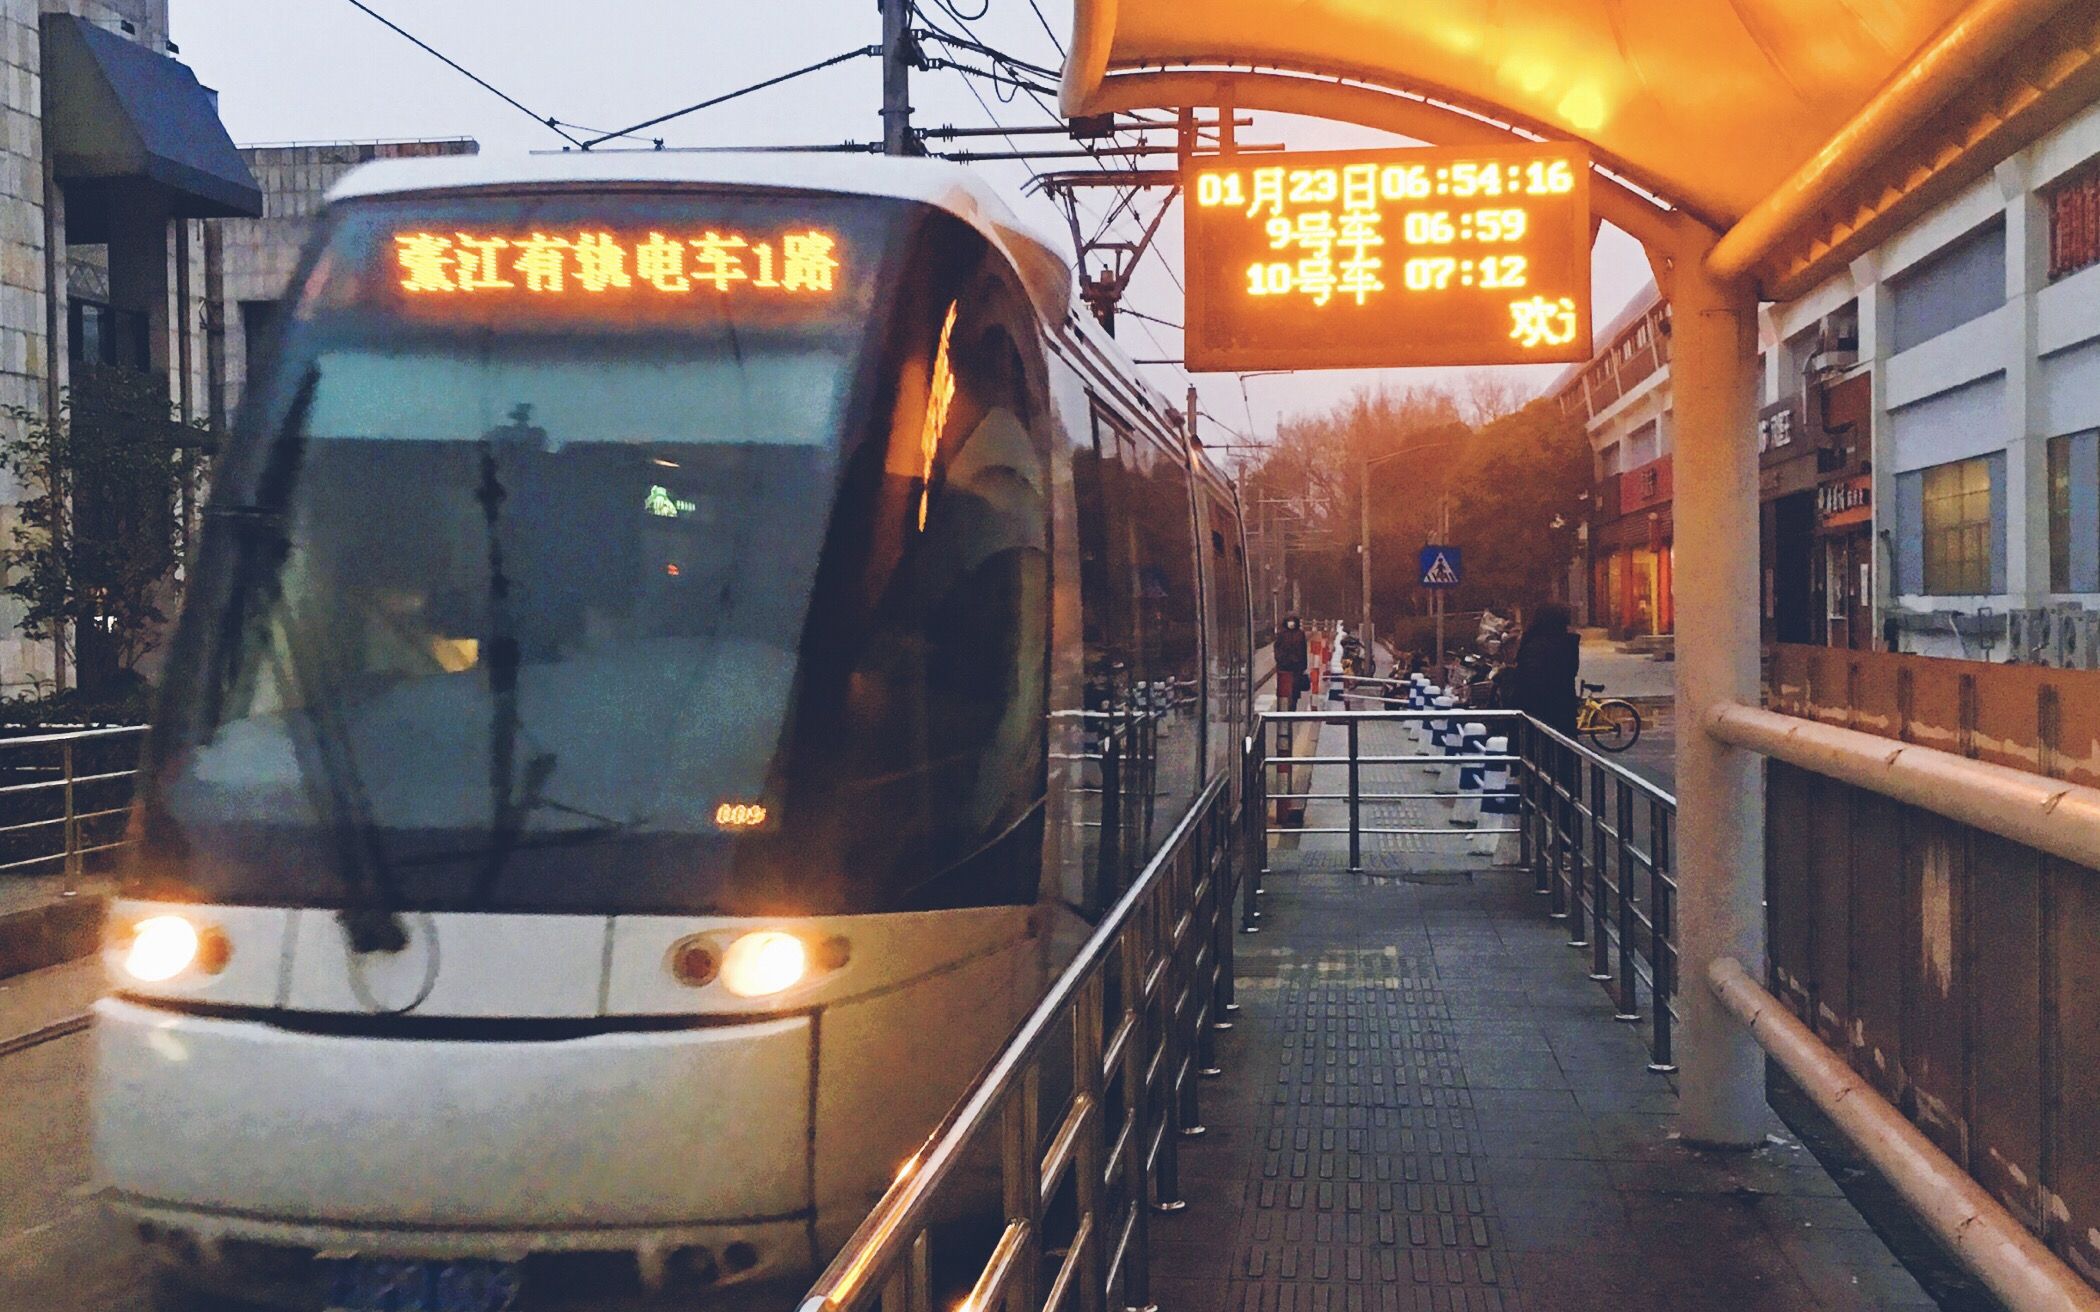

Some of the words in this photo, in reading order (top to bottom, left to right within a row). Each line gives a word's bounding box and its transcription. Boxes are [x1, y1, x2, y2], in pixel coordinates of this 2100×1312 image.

[1265, 210, 1385, 259] 9号车
[1404, 208, 1528, 245] 06:59
[1245, 256, 1385, 307] 10号车
[1404, 256, 1529, 292] 07:12
